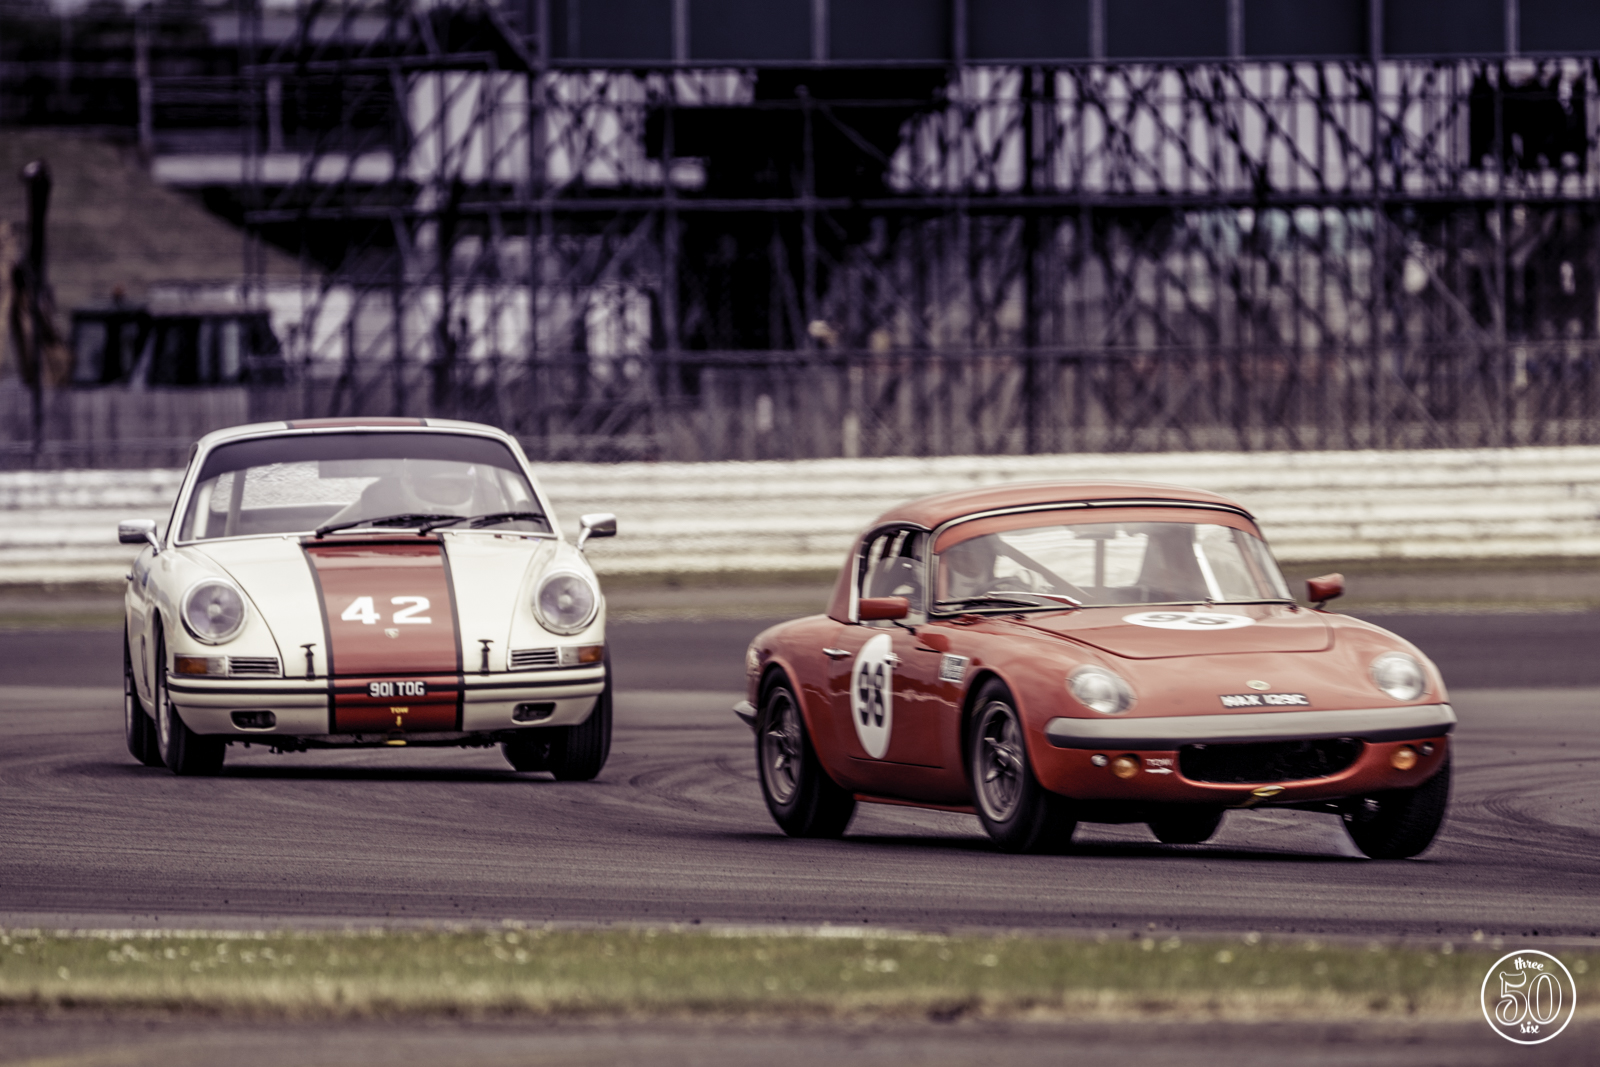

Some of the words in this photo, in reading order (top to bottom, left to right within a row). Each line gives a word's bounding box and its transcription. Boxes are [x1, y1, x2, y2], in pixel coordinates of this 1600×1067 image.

[341, 596, 432, 625] 42
[1139, 614, 1235, 625] 98
[369, 682, 394, 698] 901
[396, 681, 425, 697] TOG
[858, 661, 885, 728] 98
[390, 706, 409, 714] TOW
